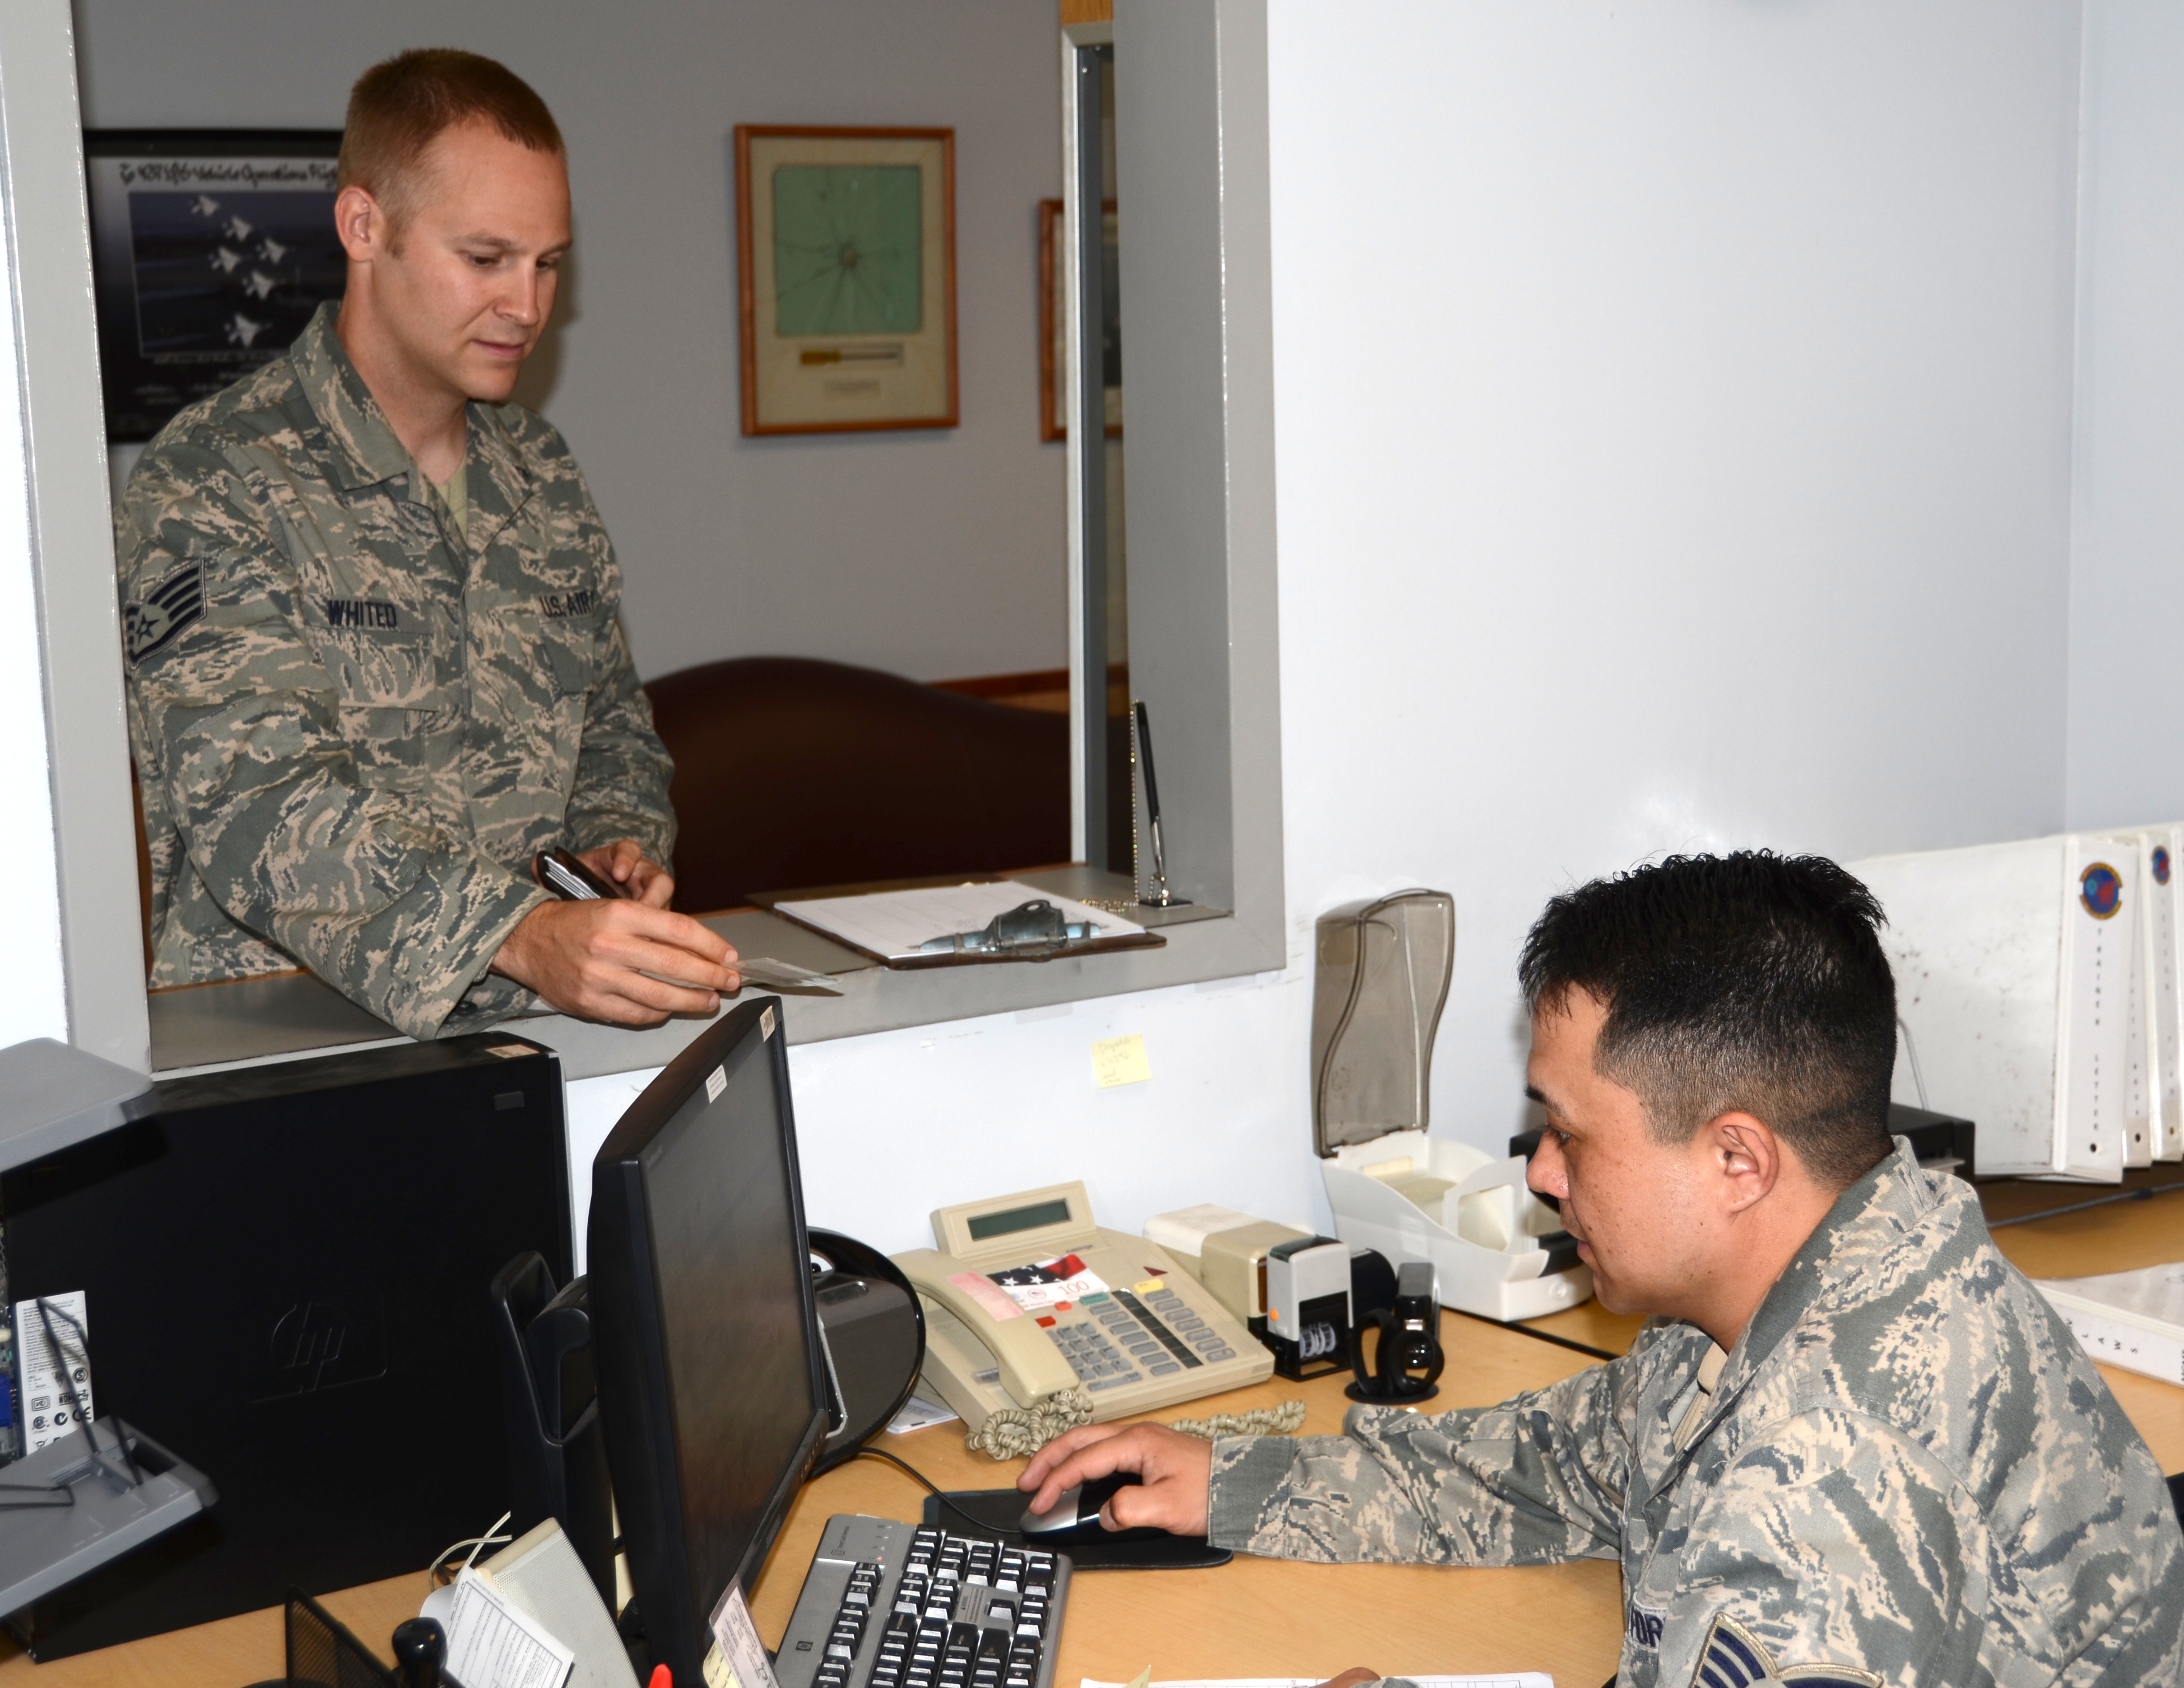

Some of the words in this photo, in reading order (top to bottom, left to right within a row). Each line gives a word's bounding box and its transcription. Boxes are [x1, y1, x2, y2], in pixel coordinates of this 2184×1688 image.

[328, 599, 397, 628] WHITED
[1058, 1281, 1089, 1295] 100
[1630, 1605, 1663, 1648] FOR
